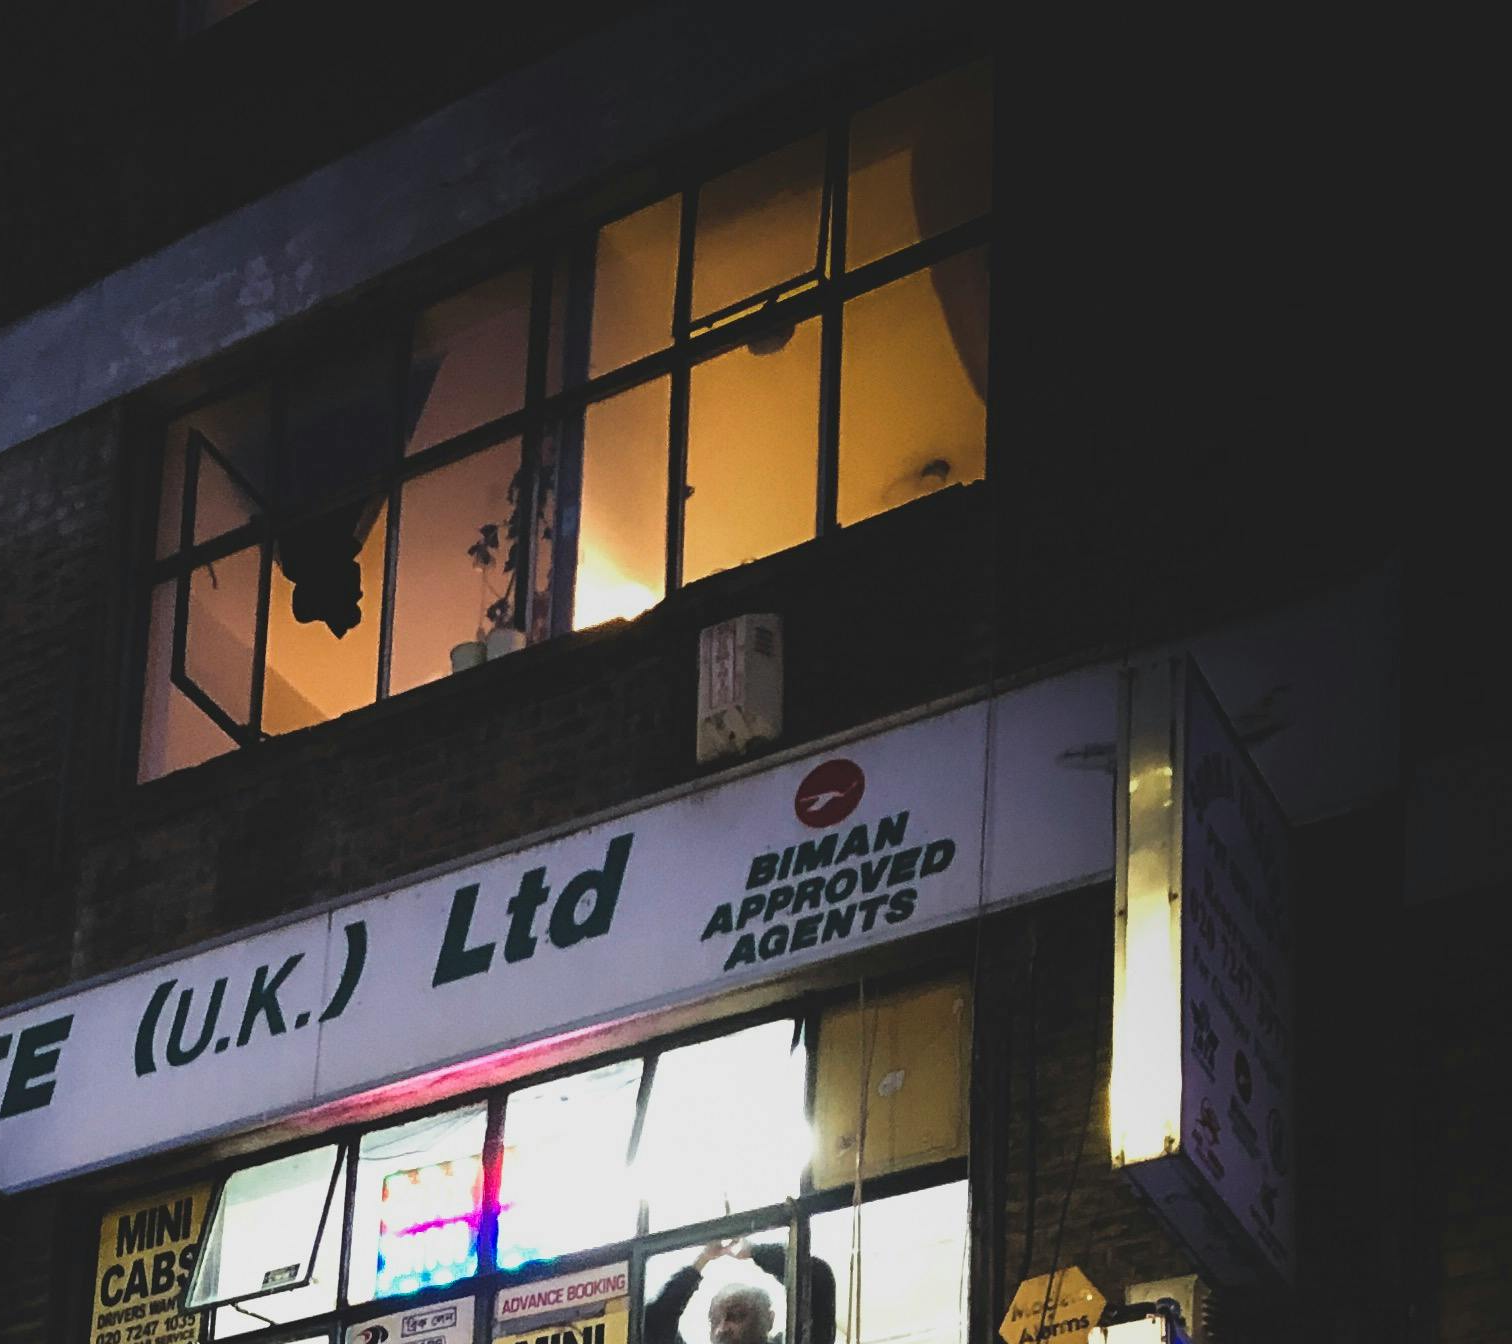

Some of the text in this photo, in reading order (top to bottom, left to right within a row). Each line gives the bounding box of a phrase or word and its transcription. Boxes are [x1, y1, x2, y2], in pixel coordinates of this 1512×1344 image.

[746, 811, 910, 890] BIMAN
[701, 838, 957, 941] APPROVED
[133, 921, 368, 1077] (U.K.)
[432, 831, 634, 988] Ltd
[723, 887, 917, 972] AGENTS
[116, 1198, 193, 1258] MINI
[101, 1244, 199, 1307] CABS
[502, 1274, 626, 1315] ADVANCE BOOKING
[98, 1302, 146, 1329] DRIVERS
[126, 1321, 159, 1342] 7247
[164, 1314, 196, 1333] 1035
